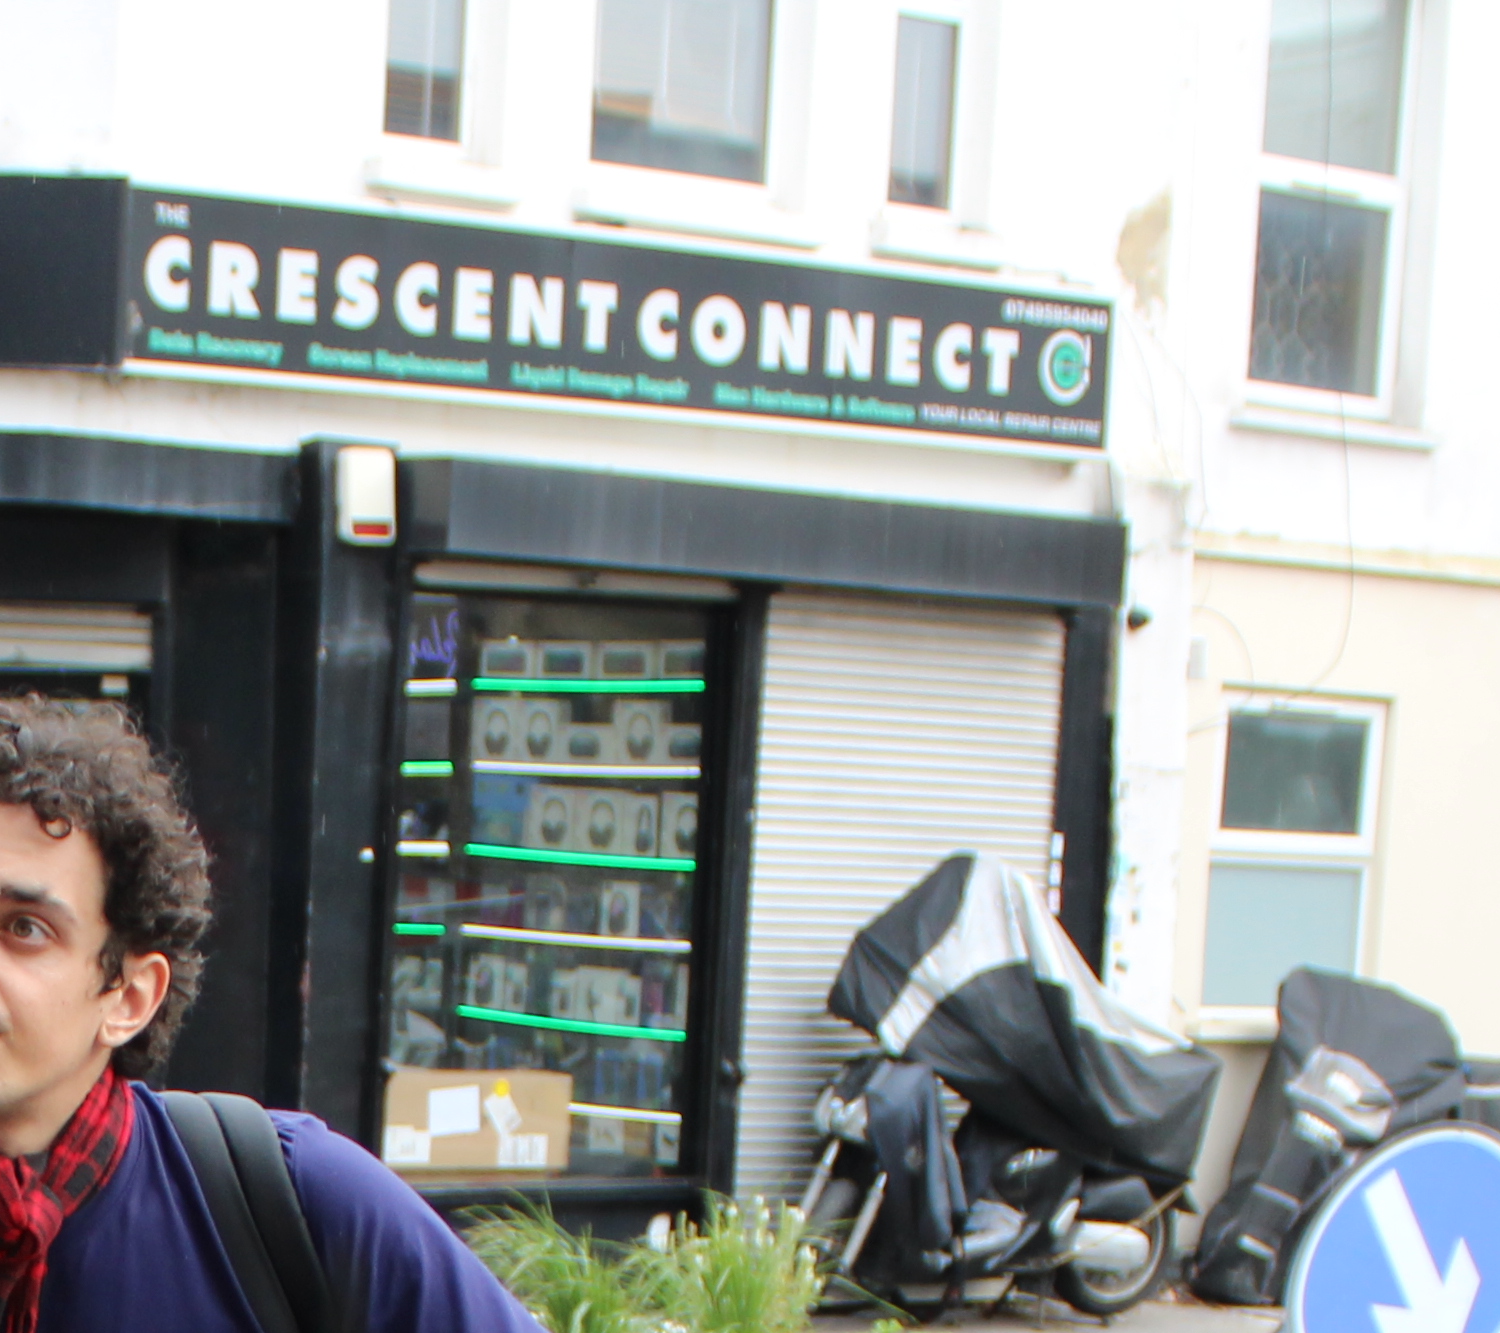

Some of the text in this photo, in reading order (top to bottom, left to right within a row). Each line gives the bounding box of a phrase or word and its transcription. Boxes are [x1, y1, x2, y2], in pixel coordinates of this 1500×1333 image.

[155, 202, 191, 229] THE
[921, 403, 1102, 439] YOUR LOCAL REPAIR CENTRE
